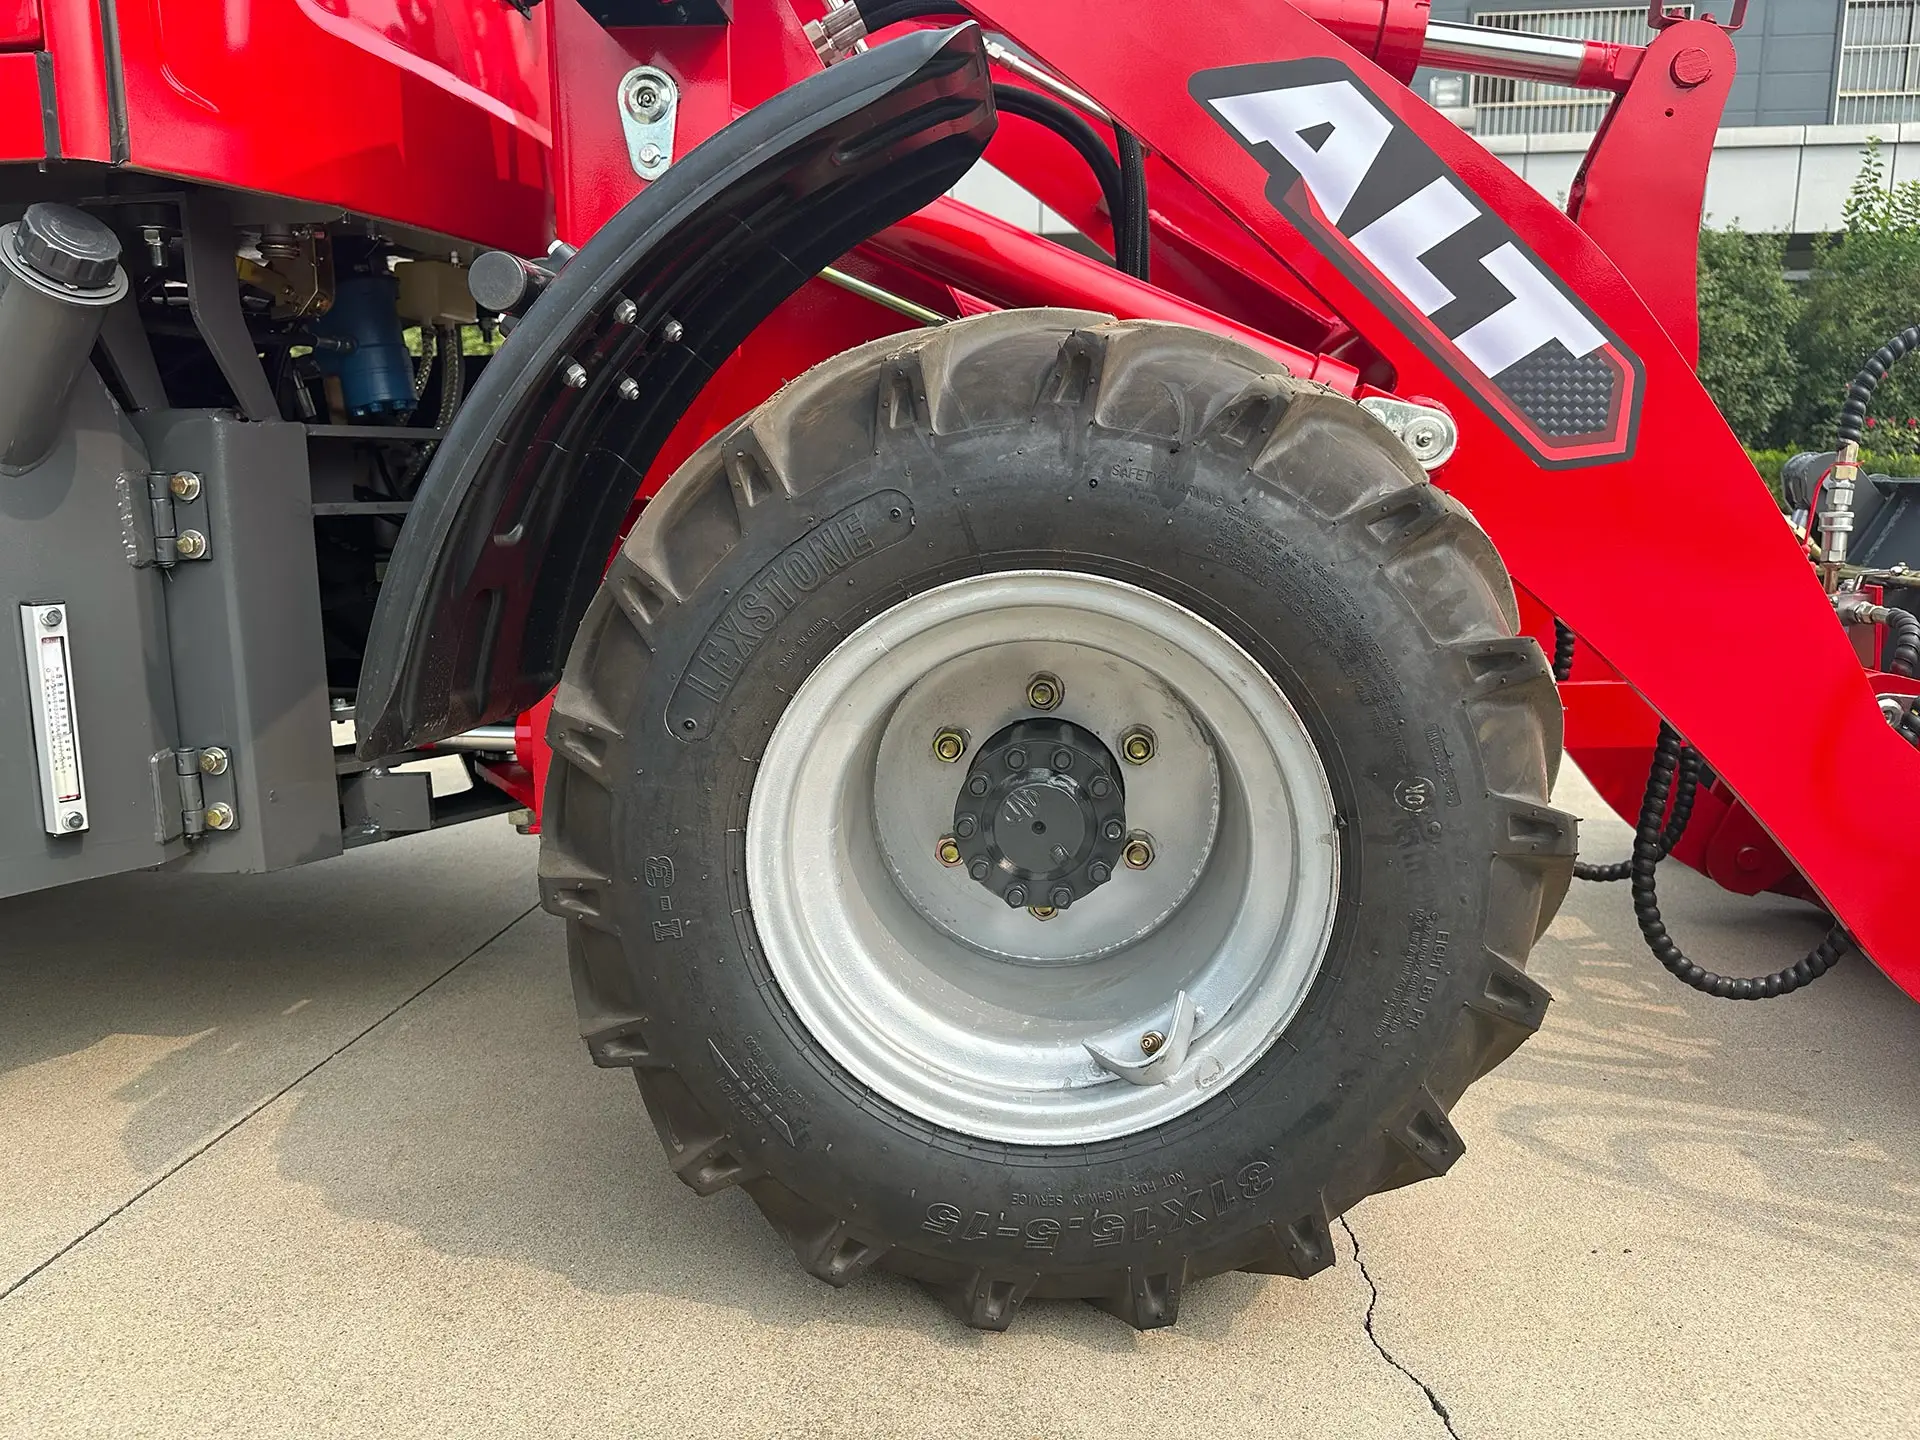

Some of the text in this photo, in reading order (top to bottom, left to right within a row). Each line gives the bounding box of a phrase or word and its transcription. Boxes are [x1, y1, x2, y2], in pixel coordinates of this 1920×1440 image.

[1208, 80, 1609, 379] ALT
[1111, 463, 1225, 508] SAFETY WARNING
[1225, 503, 1263, 529] SERIOUS
[1281, 551, 1299, 568] DUE
[684, 511, 875, 704] LEXSTONE
[805, 614, 830, 638] CHINA
[645, 855, 683, 941] I-3
[1416, 937, 1430, 962] LOAD
[1427, 929, 1451, 972] EIGHT
[714, 1074, 764, 1128] ROTATION
[740, 1054, 789, 1109] TUBELESS
[921, 1161, 1276, 1249] 31X15.5-15
[1011, 1170, 1187, 1206] NOT FOR HIGHWAY SERVICE
